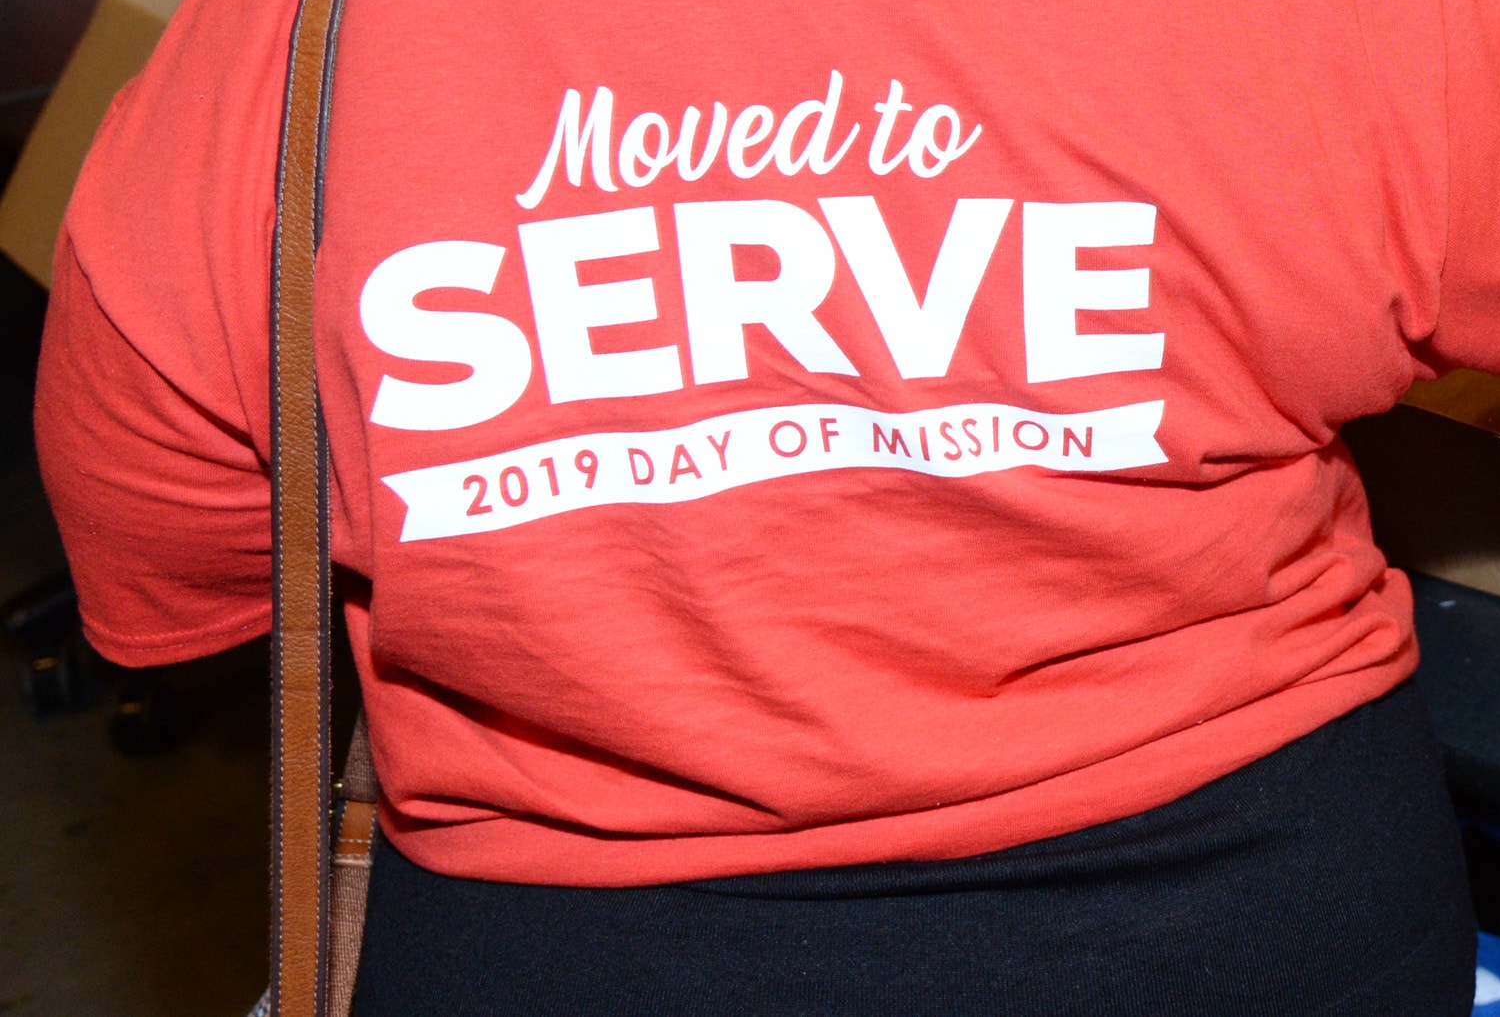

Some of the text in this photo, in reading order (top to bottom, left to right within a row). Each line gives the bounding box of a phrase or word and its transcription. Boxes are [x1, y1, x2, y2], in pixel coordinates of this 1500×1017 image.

[515, 69, 983, 210] Moved to
[358, 195, 1166, 431] SERVE
[462, 416, 1094, 517] 2019 DAY OF MISSION
